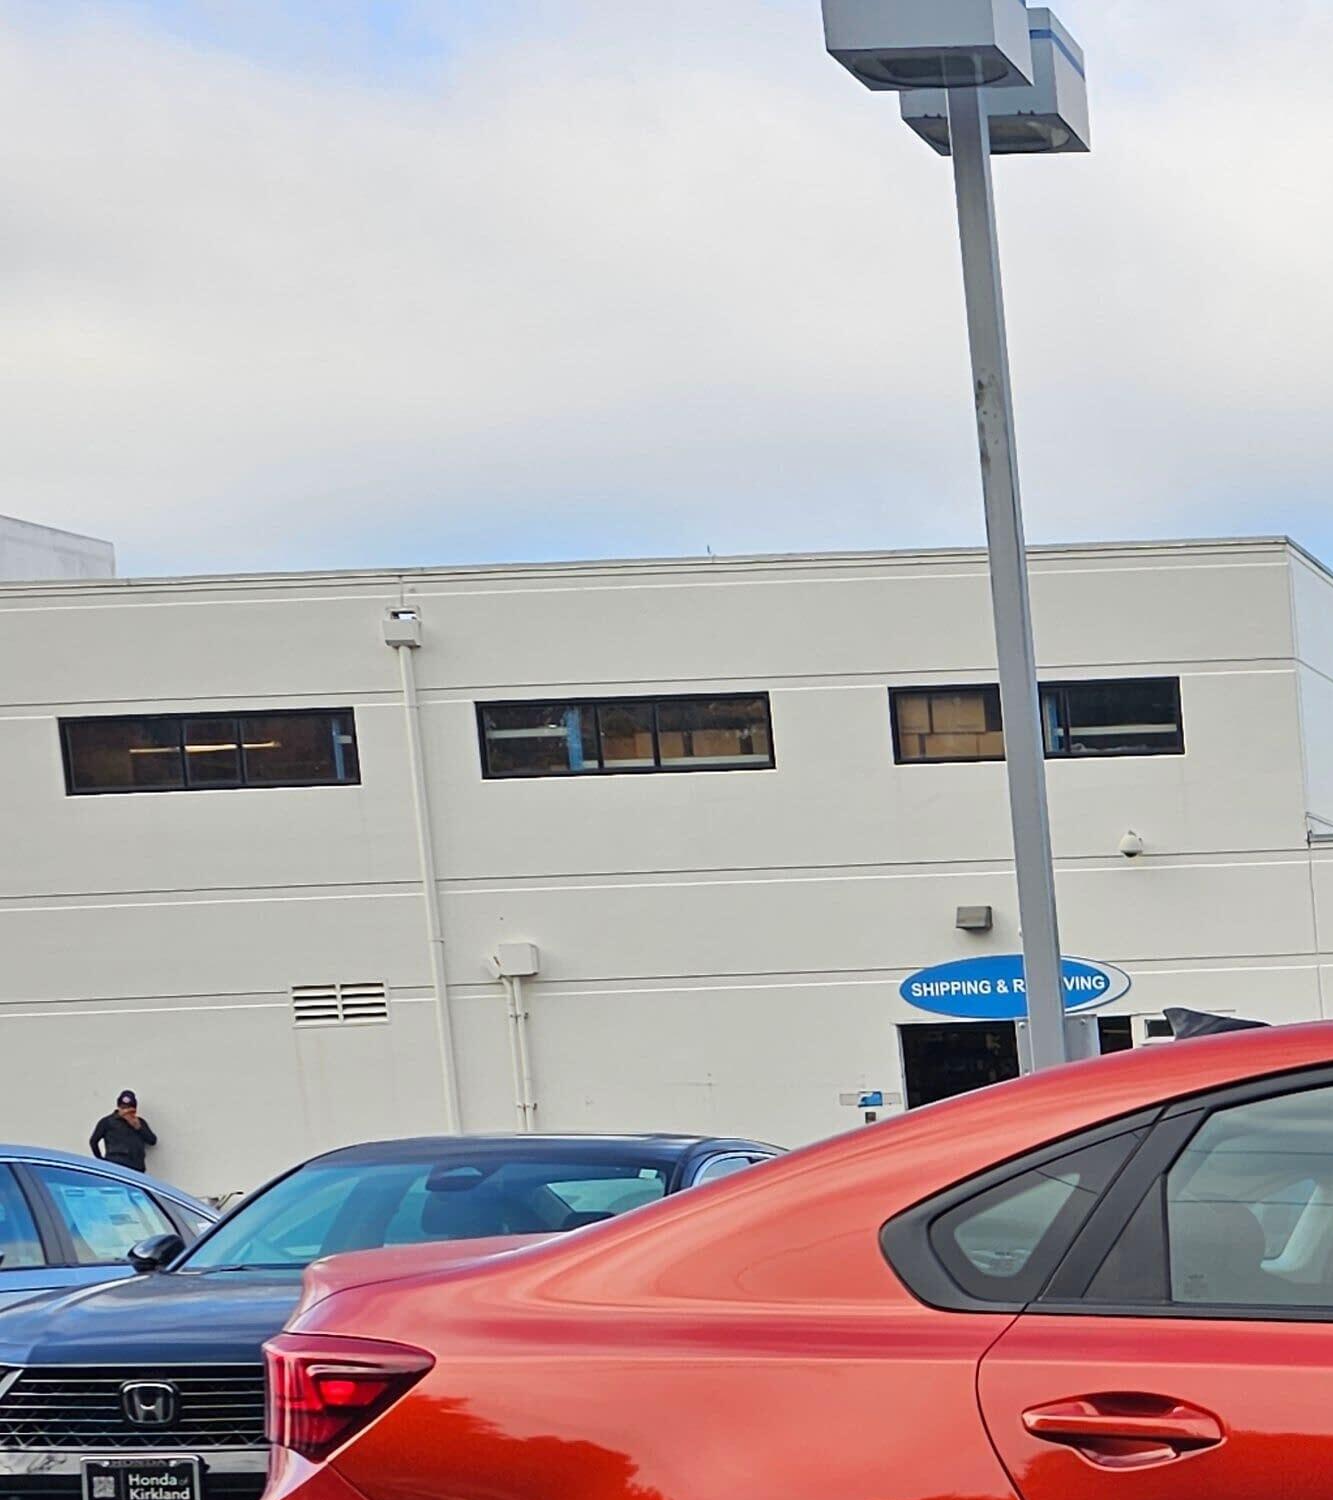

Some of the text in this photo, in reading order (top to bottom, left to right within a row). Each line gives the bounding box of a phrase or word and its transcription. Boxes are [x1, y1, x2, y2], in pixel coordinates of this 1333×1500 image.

[910, 975, 1105, 997] SHIPPING & RVING
[128, 1472, 178, 1486] Honda
[129, 1487, 191, 1500] Kirkland
